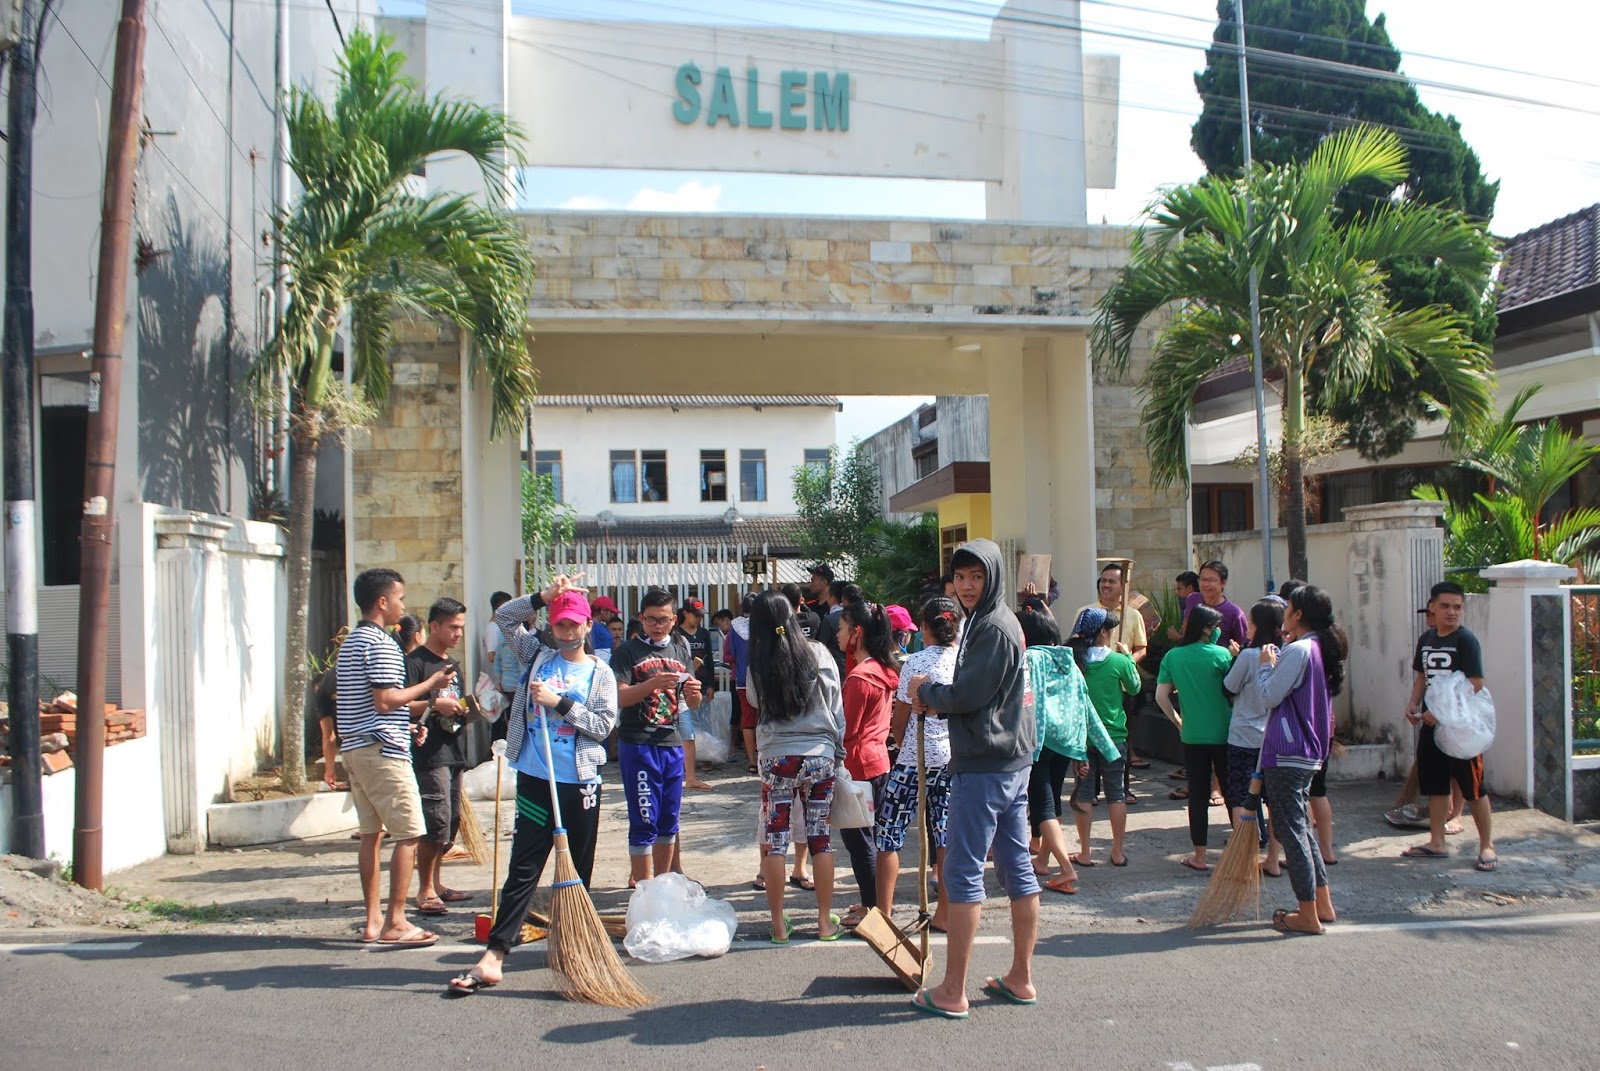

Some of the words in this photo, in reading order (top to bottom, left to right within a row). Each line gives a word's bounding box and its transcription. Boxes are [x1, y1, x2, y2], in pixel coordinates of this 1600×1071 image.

[672, 63, 849, 131] SALEM
[745, 561, 763, 573] 21
[583, 794, 597, 810] 03
[637, 770, 651, 824] adidas
